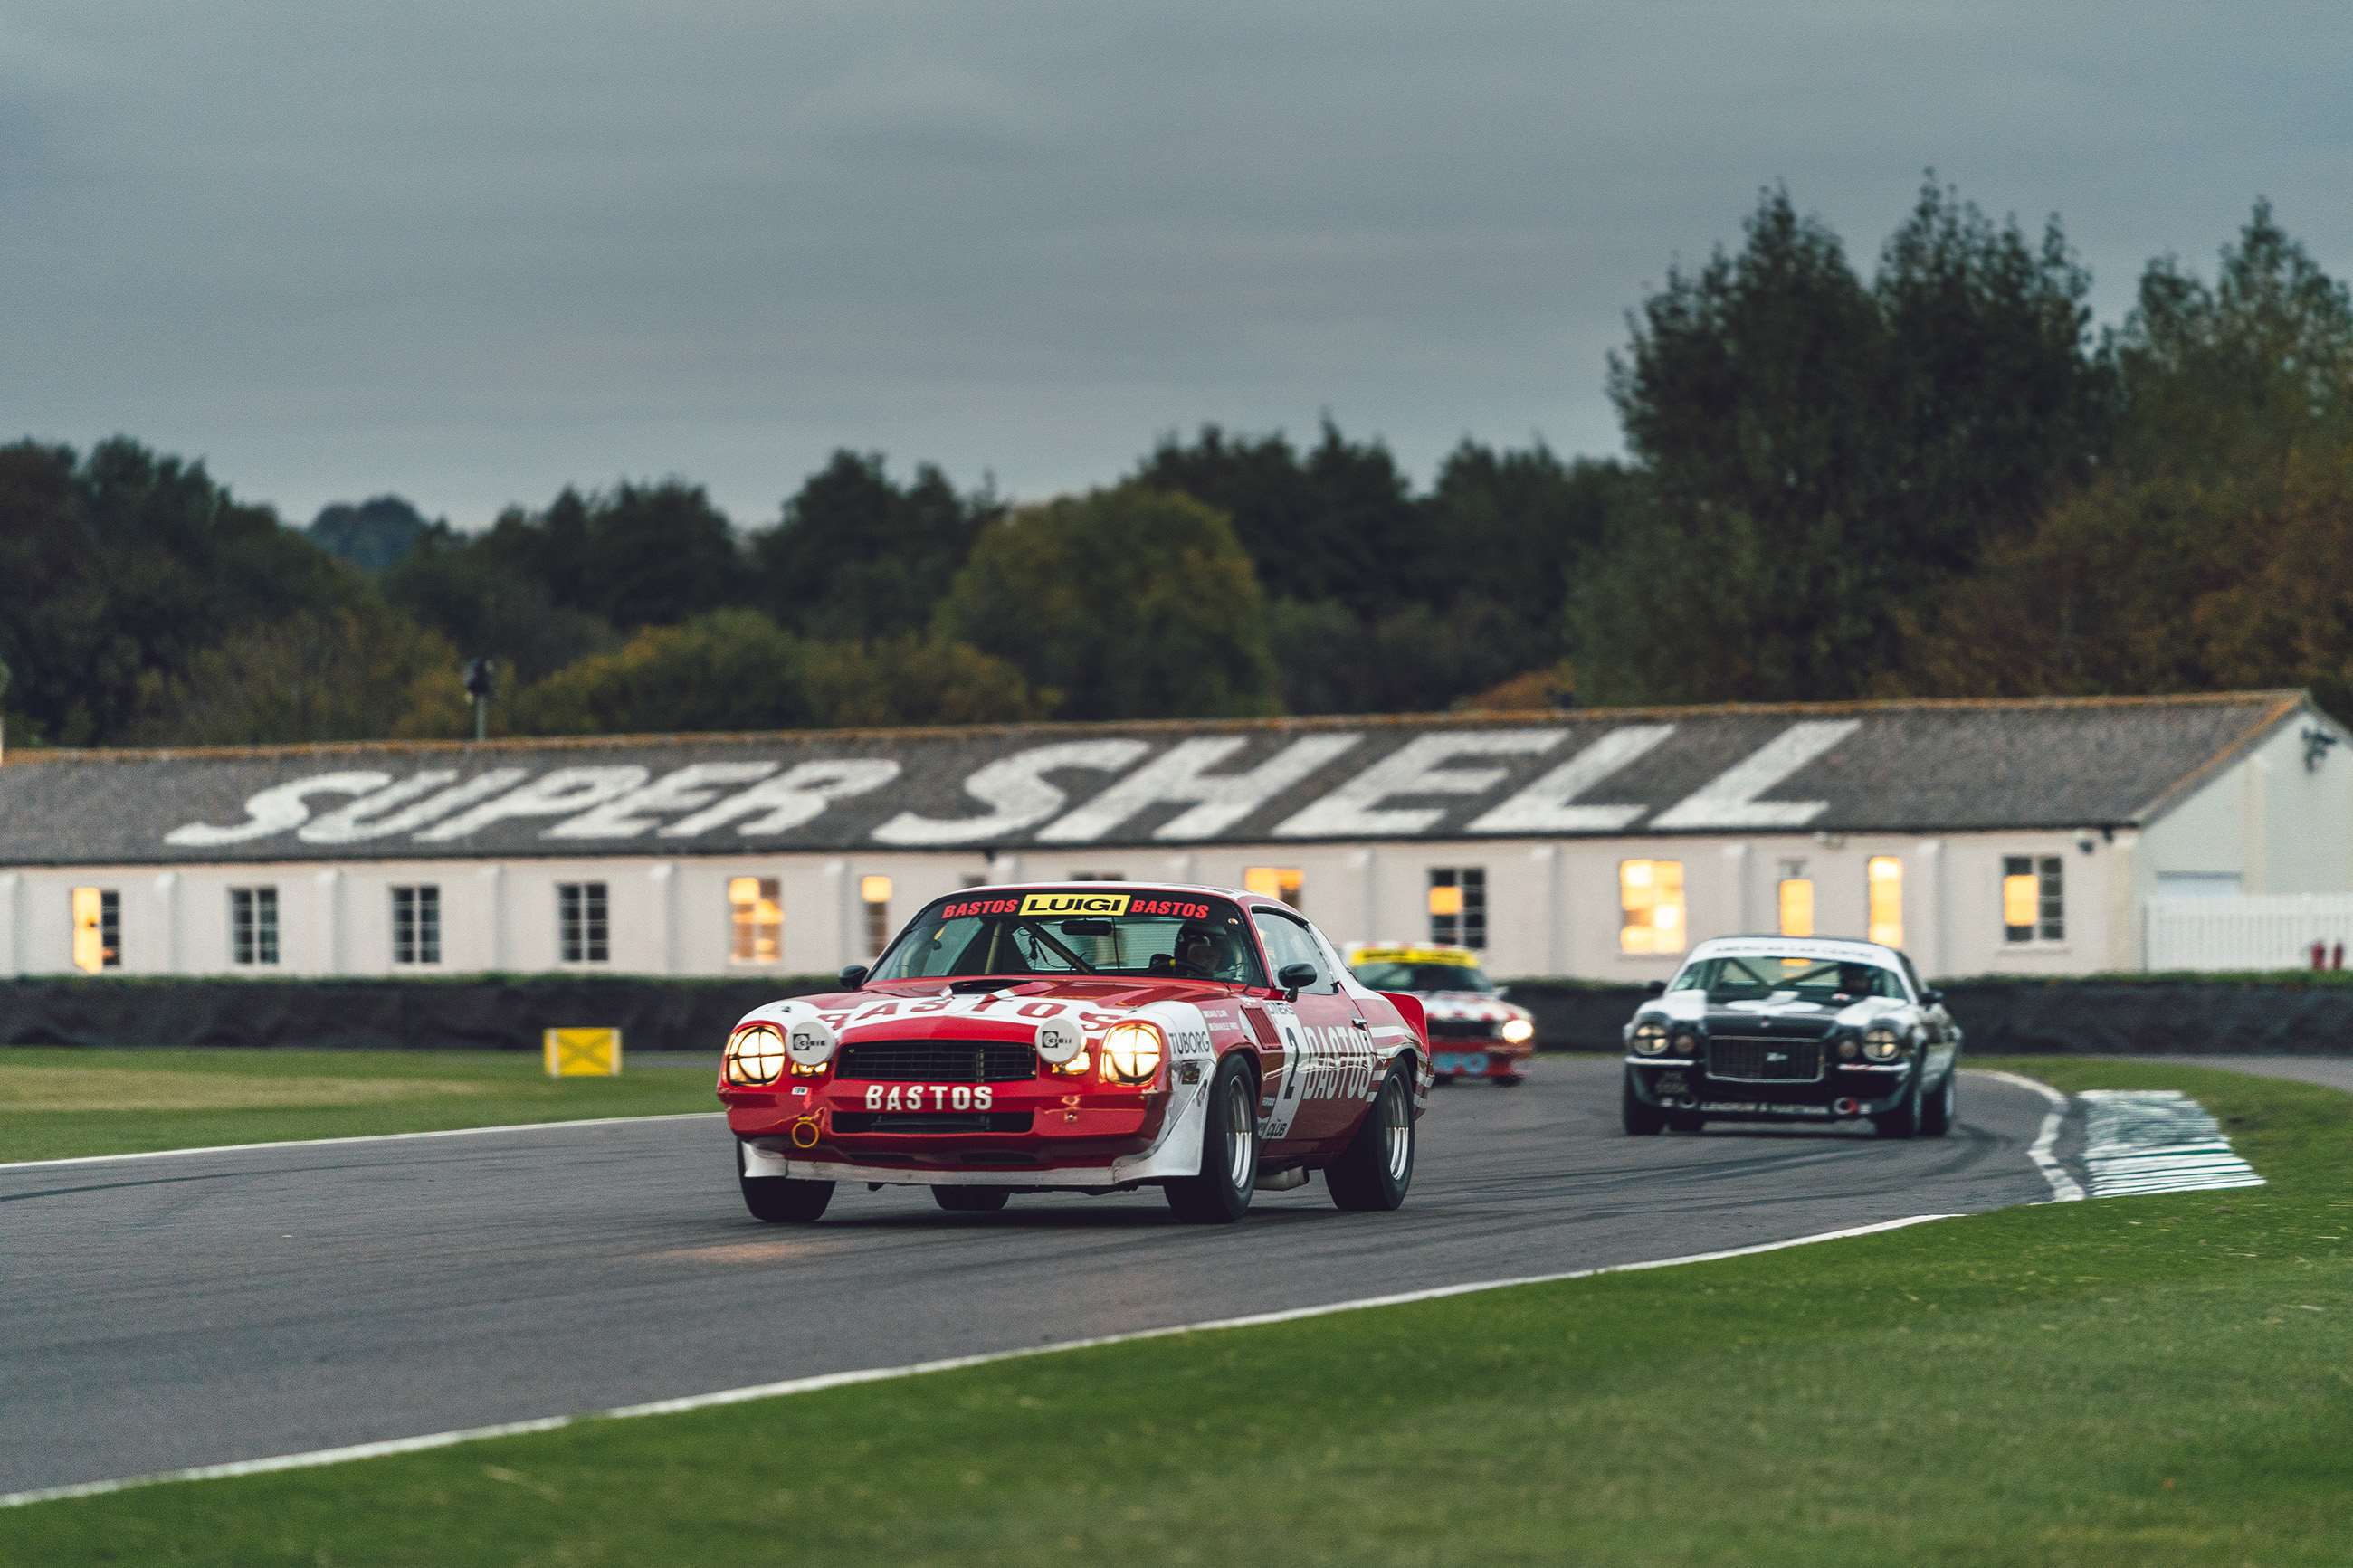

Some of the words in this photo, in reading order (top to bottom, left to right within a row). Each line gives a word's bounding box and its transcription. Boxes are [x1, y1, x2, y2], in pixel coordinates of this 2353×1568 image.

[165, 757, 901, 845] SUPER
[872, 719, 1862, 845] SHELL
[941, 899, 1020, 918] BASTOS
[1026, 898, 1121, 912] LUIGI
[1130, 899, 1210, 919] BASTOS
[1168, 1031, 1211, 1054] TUBORG
[1284, 1026, 1300, 1099] 2
[865, 1085, 993, 1110] BASTOS
